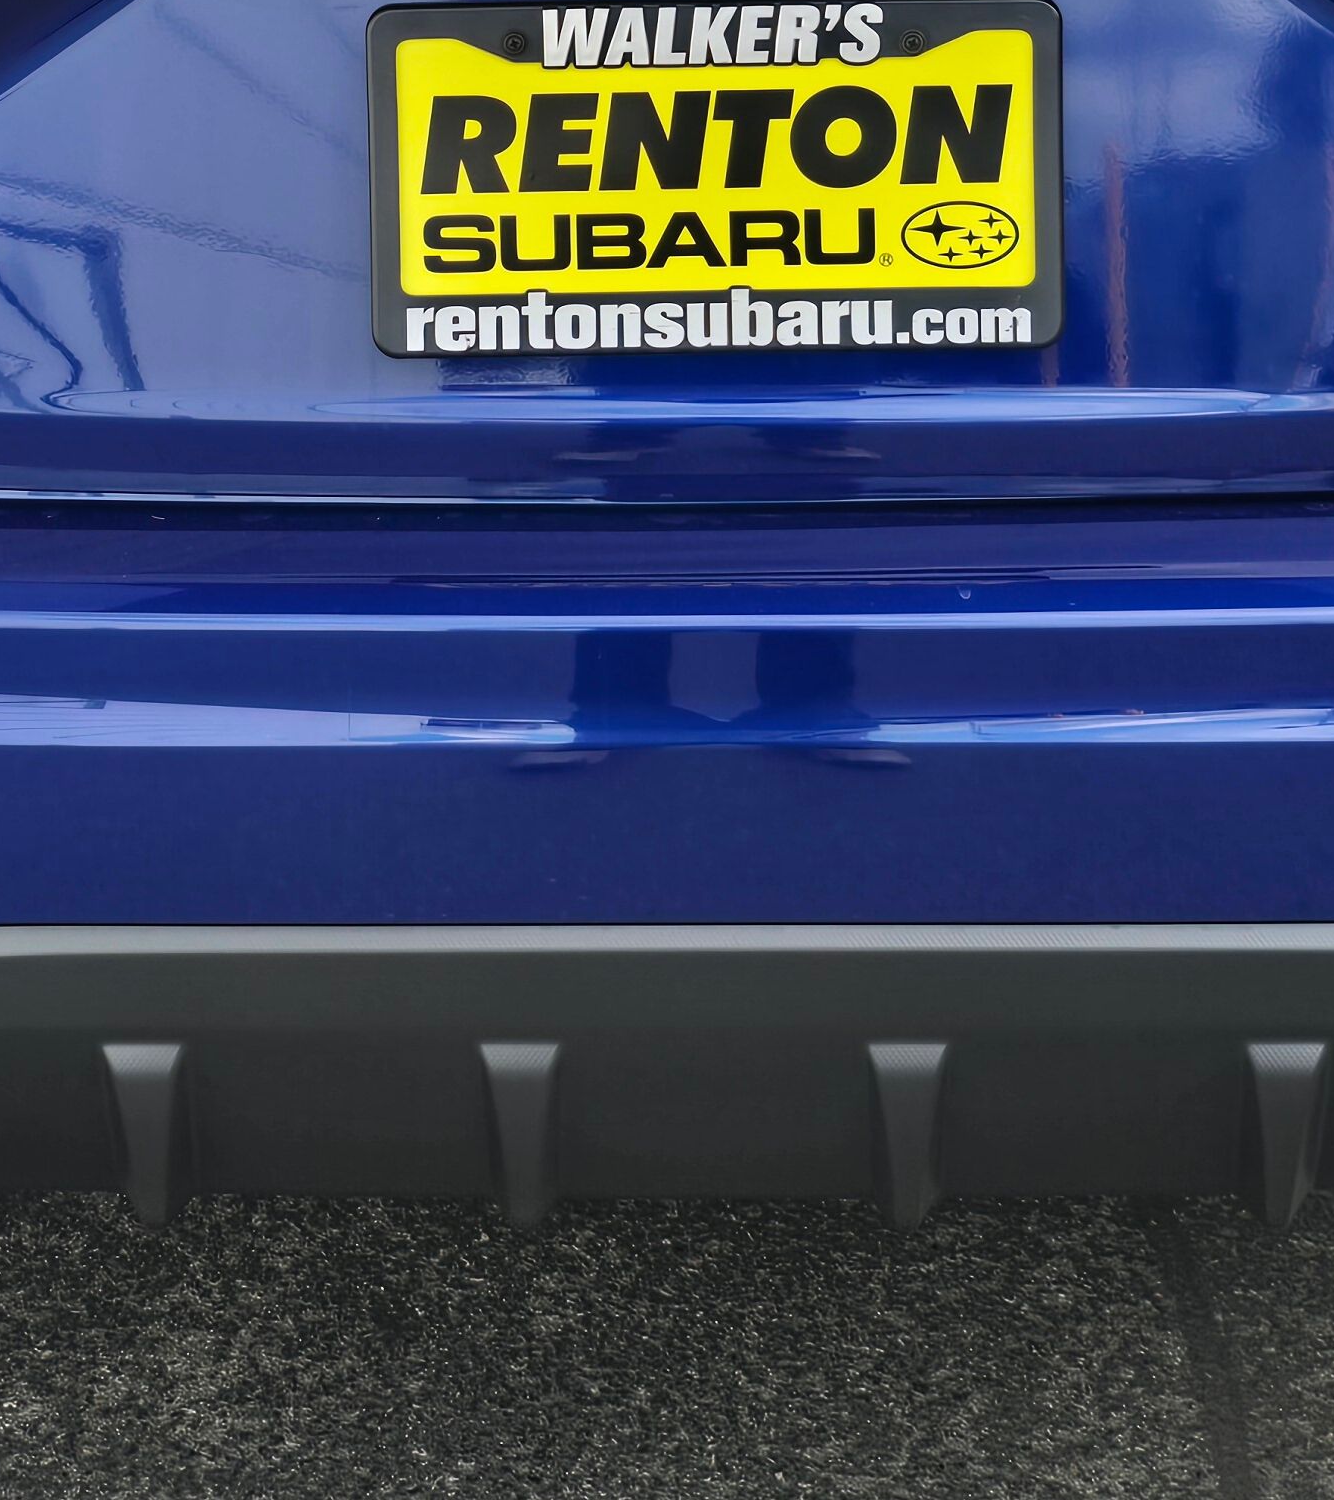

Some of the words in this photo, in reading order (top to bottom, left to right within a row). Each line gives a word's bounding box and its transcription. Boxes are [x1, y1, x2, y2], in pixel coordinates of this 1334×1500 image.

[541, 3, 884, 68] WALKER'S
[420, 84, 1013, 195] RENTON
[422, 207, 876, 273] SUBARU
[405, 287, 1032, 353] rentonsubaru.com
